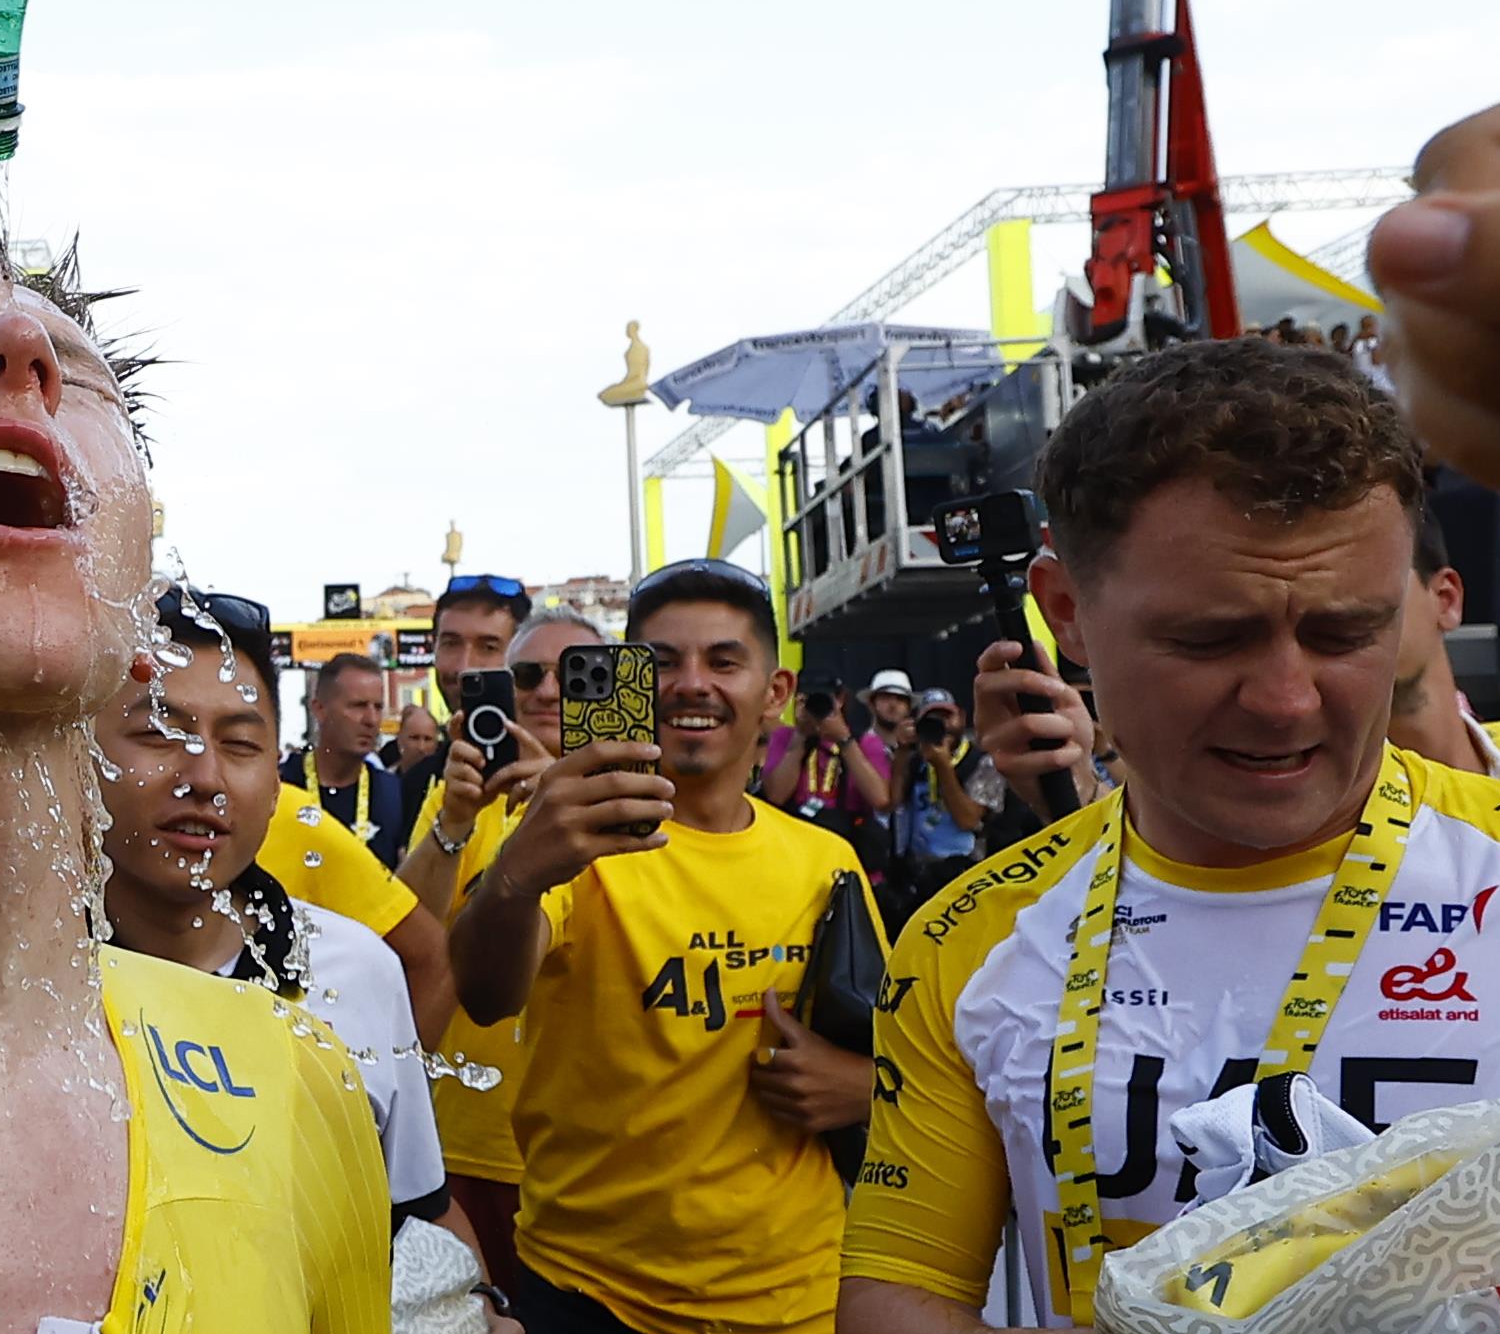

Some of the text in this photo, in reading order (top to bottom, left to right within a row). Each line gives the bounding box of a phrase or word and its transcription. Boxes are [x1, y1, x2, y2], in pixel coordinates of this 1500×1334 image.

[921, 832, 1072, 946] presight
[1113, 905, 1133, 918] CI
[1379, 902, 1468, 934] FAB
[689, 931, 745, 950] ALL
[1101, 989, 1169, 1006] ISSEI
[1378, 1007, 1479, 1023] etisalat and
[146, 1020, 257, 1099] LCL
